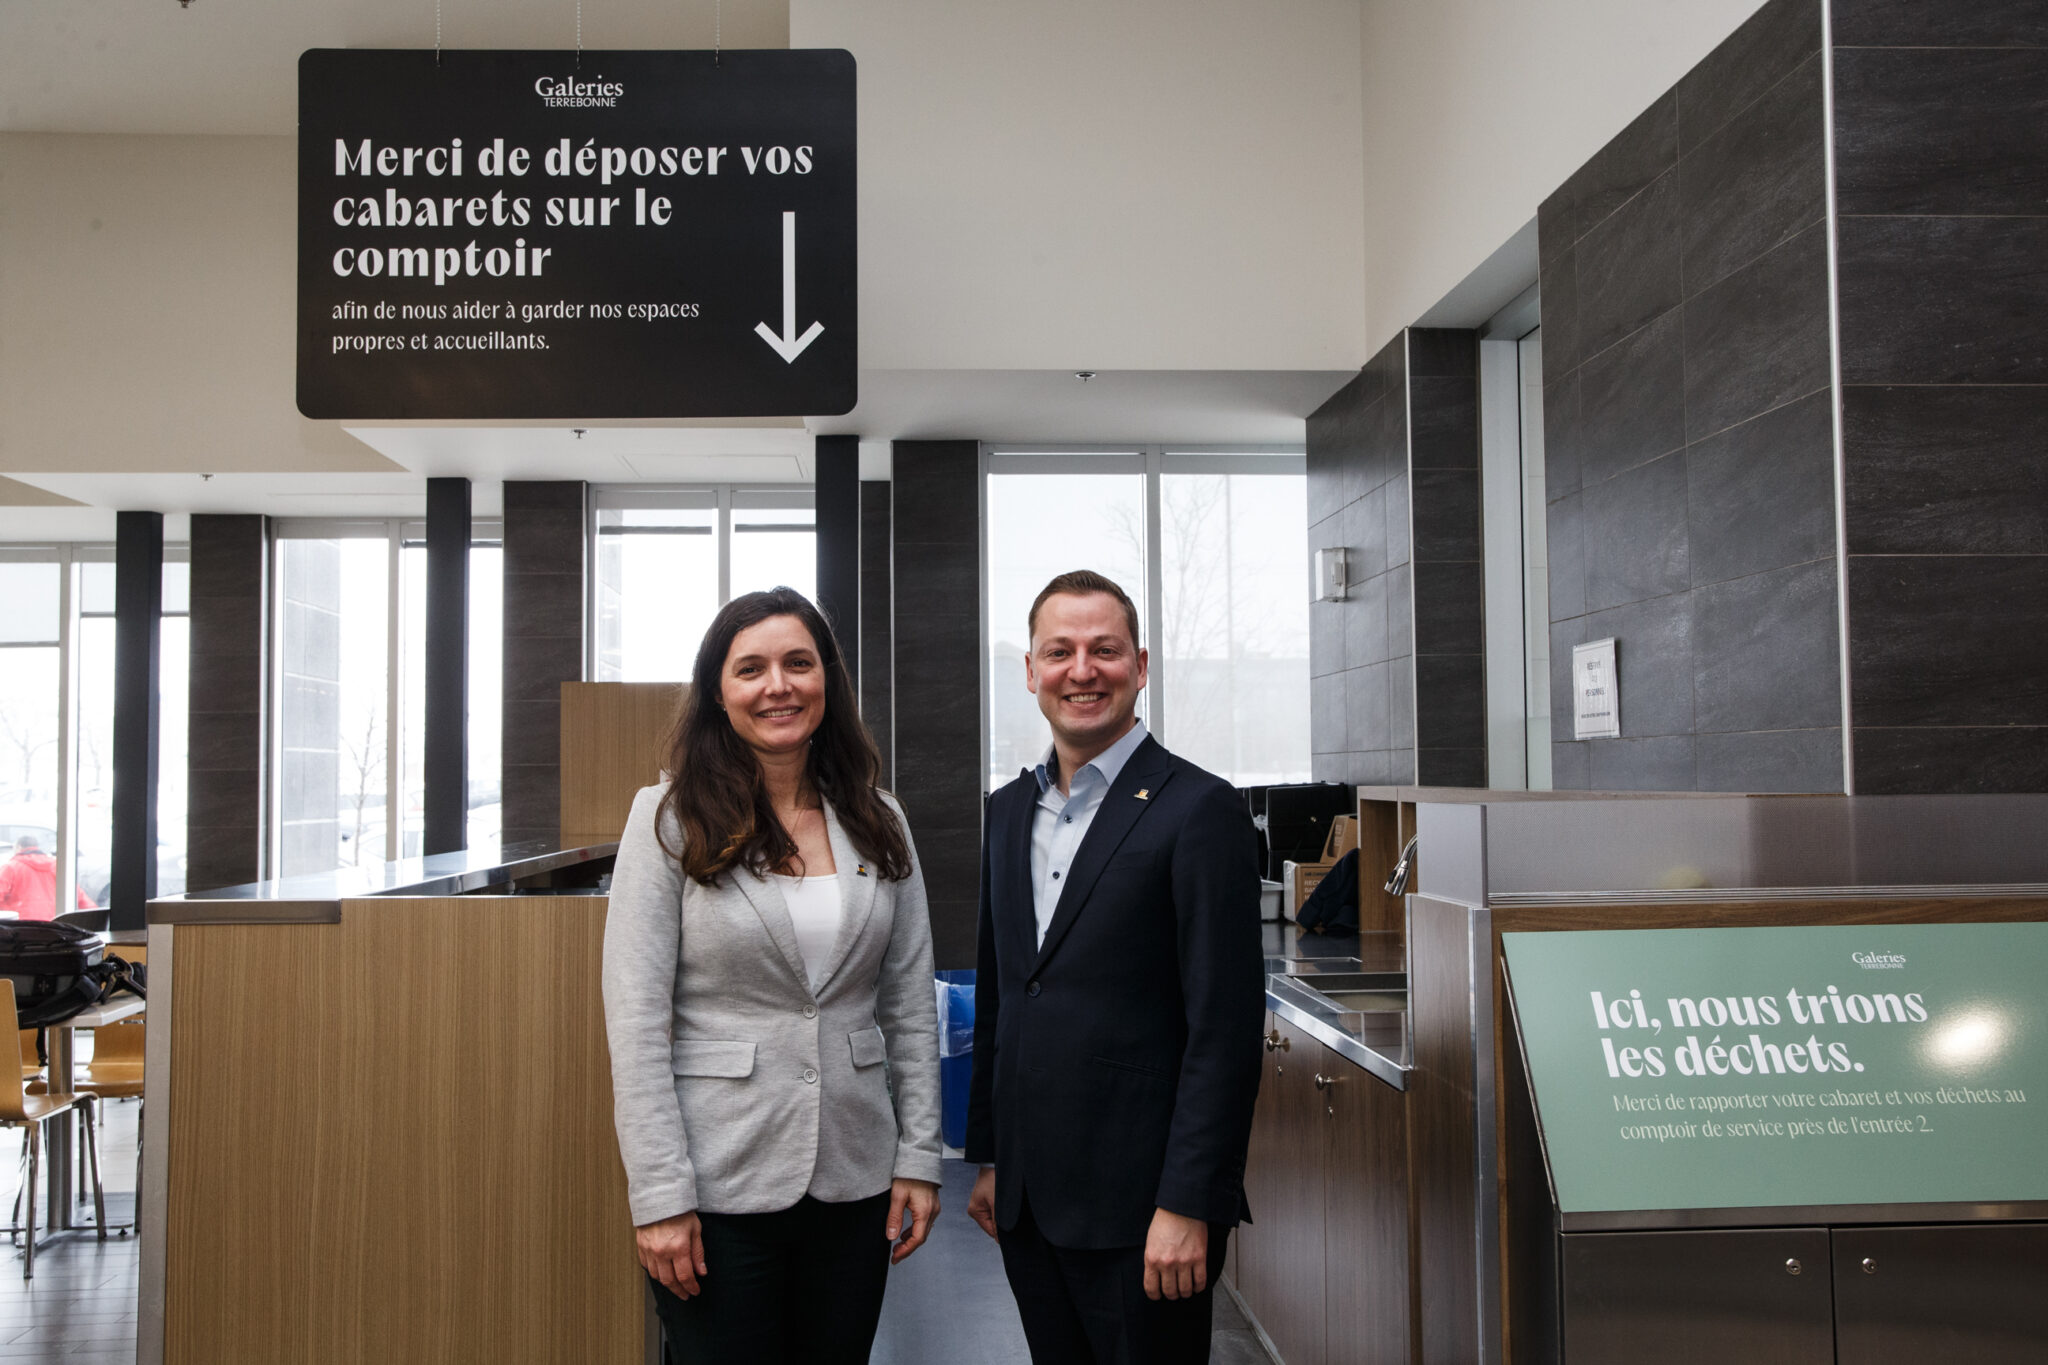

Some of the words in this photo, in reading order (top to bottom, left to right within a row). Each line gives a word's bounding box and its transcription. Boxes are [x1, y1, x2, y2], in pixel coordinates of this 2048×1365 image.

[534, 74, 624, 97] Galeries
[543, 97, 617, 108] TERREBONNE
[335, 137, 463, 177] Merci
[477, 138, 531, 177] de
[544, 137, 728, 185] déposer
[740, 145, 813, 175] vos
[333, 188, 531, 227] cabarets
[545, 197, 620, 227] sur
[635, 187, 672, 226] le
[332, 237, 552, 286] comptoir
[331, 300, 368, 320] afin
[373, 300, 396, 320] de
[402, 304, 448, 320] nous
[452, 300, 501, 320] aider
[505, 300, 516, 319] à
[521, 299, 585, 323] garder
[590, 303, 622, 319] nos
[627, 303, 700, 322] espaces
[332, 335, 405, 355] propres
[410, 333, 429, 350] et
[433, 330, 550, 350] accueillants.
[1851, 950, 1907, 964] Galeries
[1590, 988, 1662, 1036] Ici,
[1667, 995, 1781, 1027] nous
[1786, 985, 1928, 1025] trions
[1601, 1037, 1666, 1078] les
[1674, 1034, 1865, 1077] déchets.
[1613, 1094, 1662, 1112] Merci
[1665, 1093, 1686, 1110] de
[1689, 1093, 1769, 1113] rapporter
[1772, 1092, 1816, 1109] votre
[1819, 1089, 1883, 1107] cabaret
[1886, 1089, 1903, 1105] et
[1904, 1090, 1934, 1105] vos
[1935, 1086, 2001, 1105] déchets
[2005, 1089, 2027, 1103] au
[1620, 1120, 1698, 1143] comptoir
[1702, 1120, 1723, 1137] de
[1726, 1119, 1785, 1137] service
[1787, 1117, 1825, 1139] près
[1827, 1117, 1849, 1134] de
[1850, 1115, 1914, 1134] l'entrée
[1916, 1114, 1934, 1132] 2.
